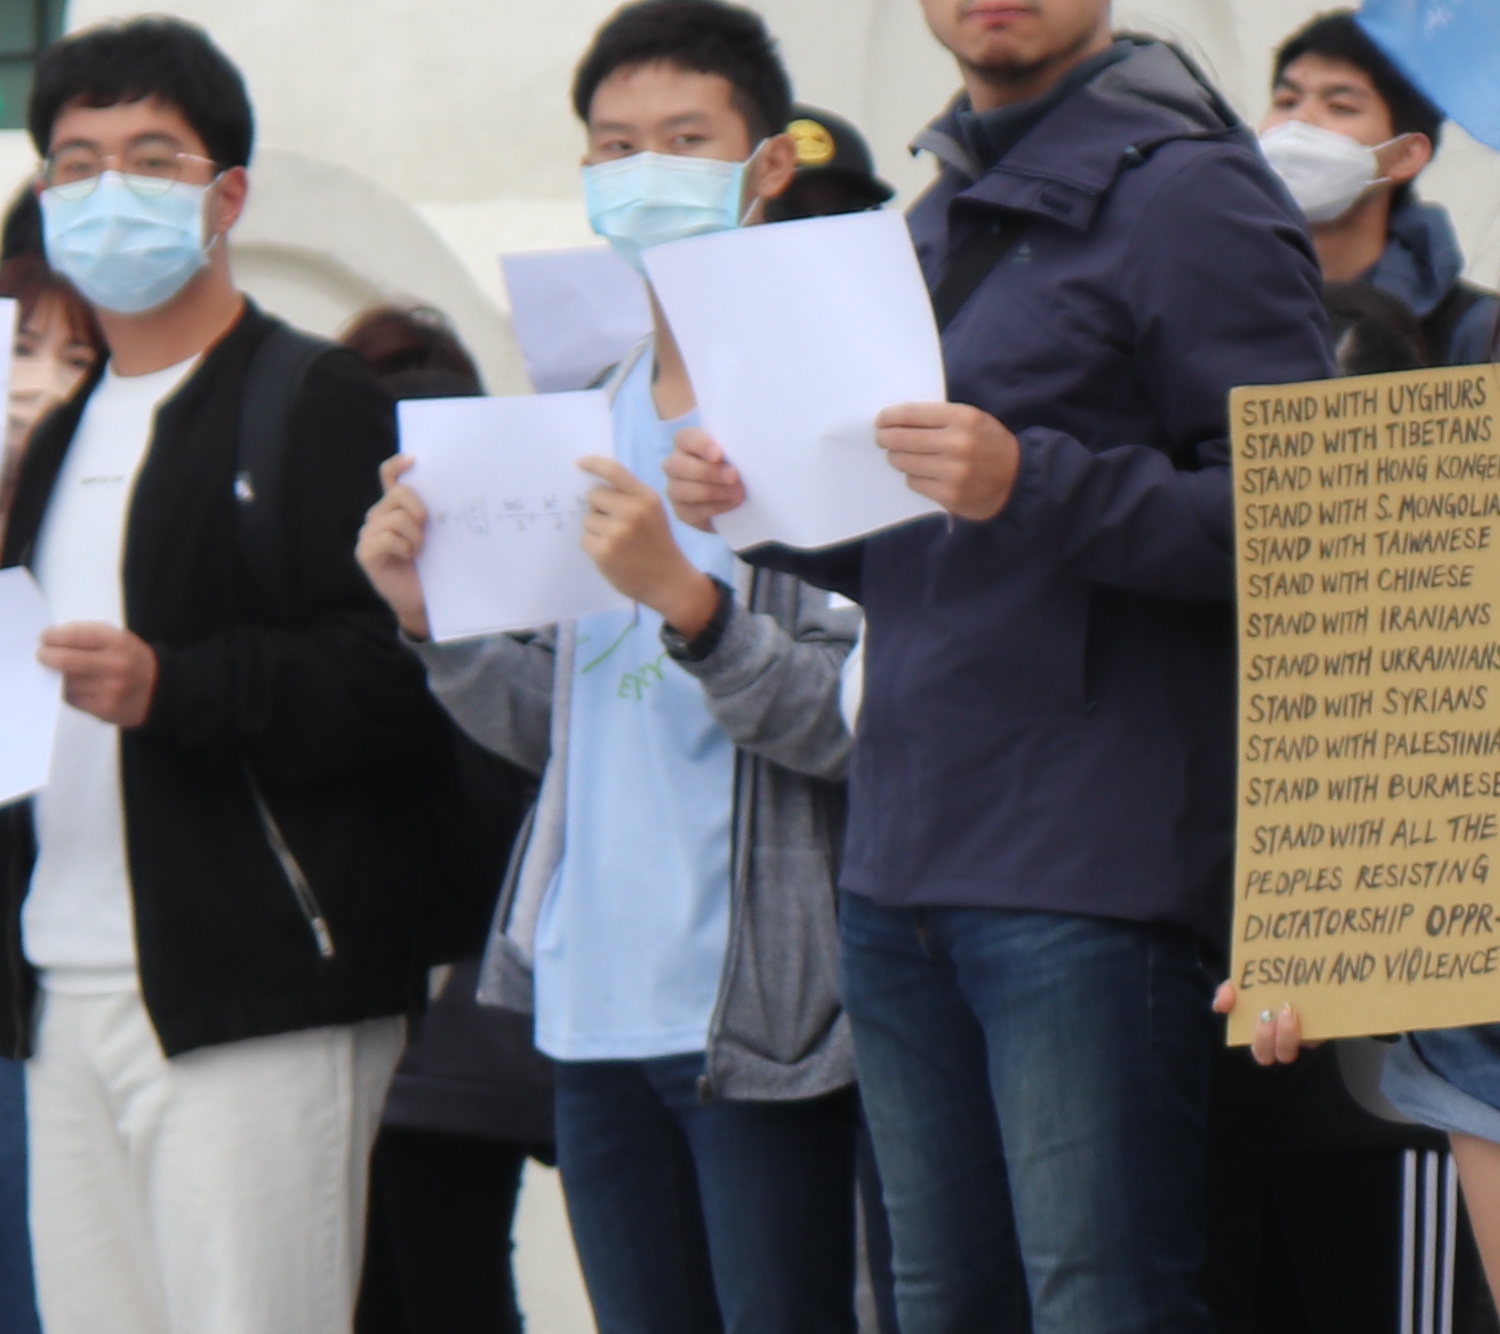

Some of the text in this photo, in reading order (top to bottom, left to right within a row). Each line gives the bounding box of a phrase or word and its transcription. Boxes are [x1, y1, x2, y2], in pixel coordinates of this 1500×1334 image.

[1243, 376, 1486, 426] STAND WITH UYGHURS
[1242, 415, 1492, 459] STAND WITH TIBETANS
[1242, 466, 1311, 496] STAND
[1319, 460, 1369, 487] WITH
[1377, 456, 1428, 484] HONG
[1245, 502, 1312, 529] STAND
[1319, 497, 1368, 525] WITH
[1376, 493, 1391, 520] S.
[1245, 526, 1491, 565] STAND WITH TAIWANESE
[1249, 565, 1473, 599] STAND WITH CHINESE
[1246, 603, 1491, 639] STAND WITH IRANIANS
[1247, 654, 1319, 681] STAND
[1324, 646, 1372, 676] WITH
[1249, 685, 1487, 724] STAND WITH SYRIANS
[1246, 735, 1318, 762] STAND
[1326, 729, 1377, 758] WITH
[1246, 777, 1319, 807] STAND
[1328, 773, 1379, 803] WITH
[1252, 814, 1498, 856] STAND WITH ALL THE
[1245, 853, 1489, 899] PEOPLES RESISTING
[1244, 904, 1414, 942] DICTATORSHIP
[1240, 946, 1500, 990] ESSION AND VIOLENCE
